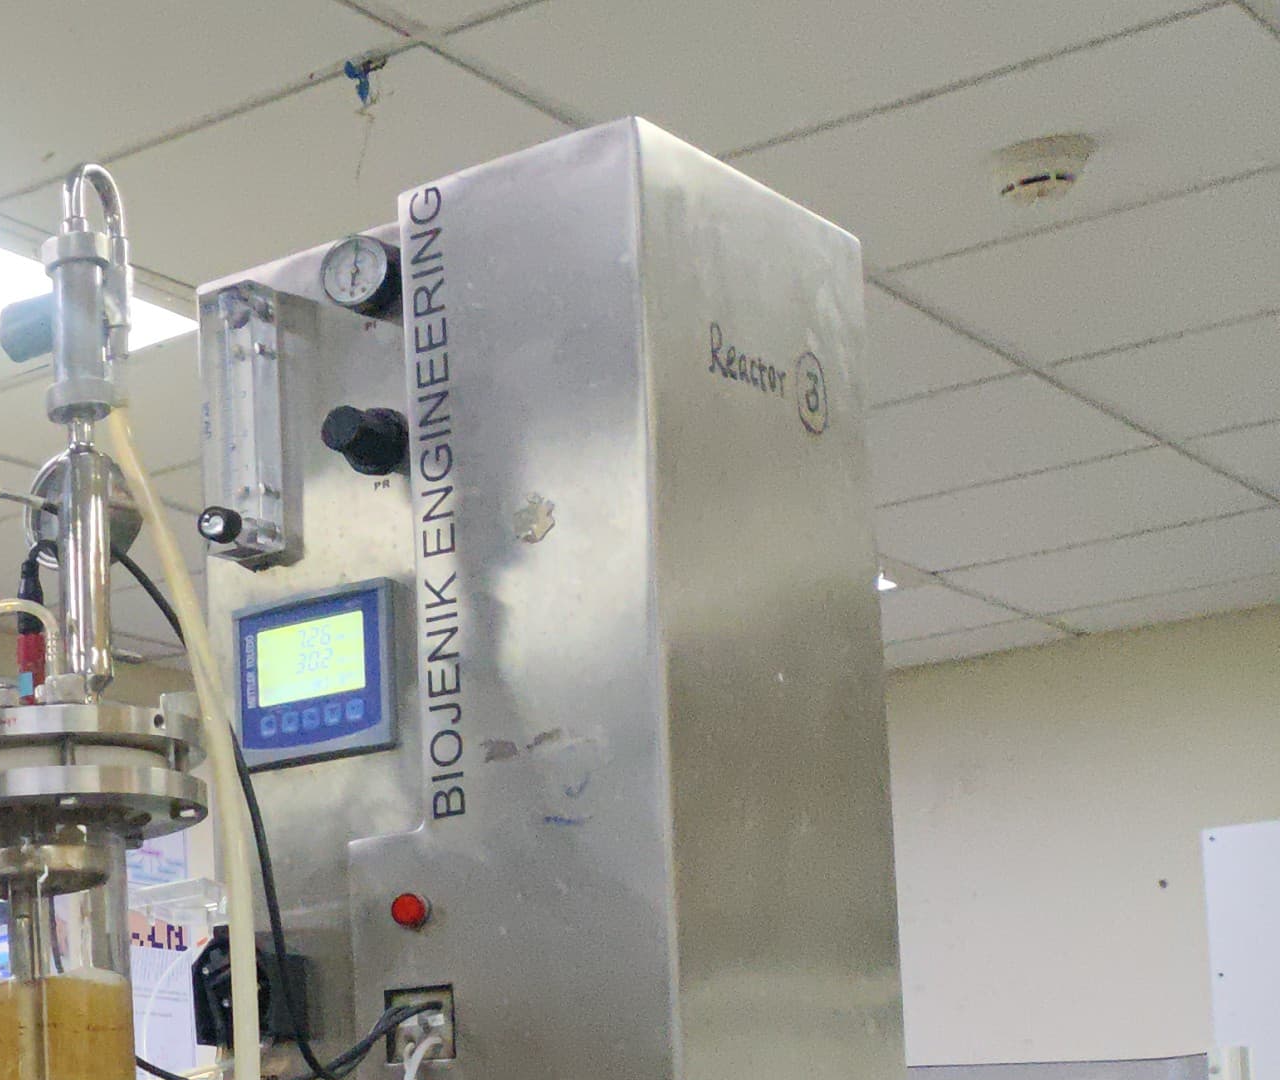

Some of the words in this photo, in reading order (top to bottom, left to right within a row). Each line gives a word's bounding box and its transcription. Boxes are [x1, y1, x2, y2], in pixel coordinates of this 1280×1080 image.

[410, 186, 455, 557] ENGINEERING
[708, 322, 786, 399] Reactor
[245, 634, 255, 669] TOLEDO
[424, 571, 465, 819] BIOJENIK
